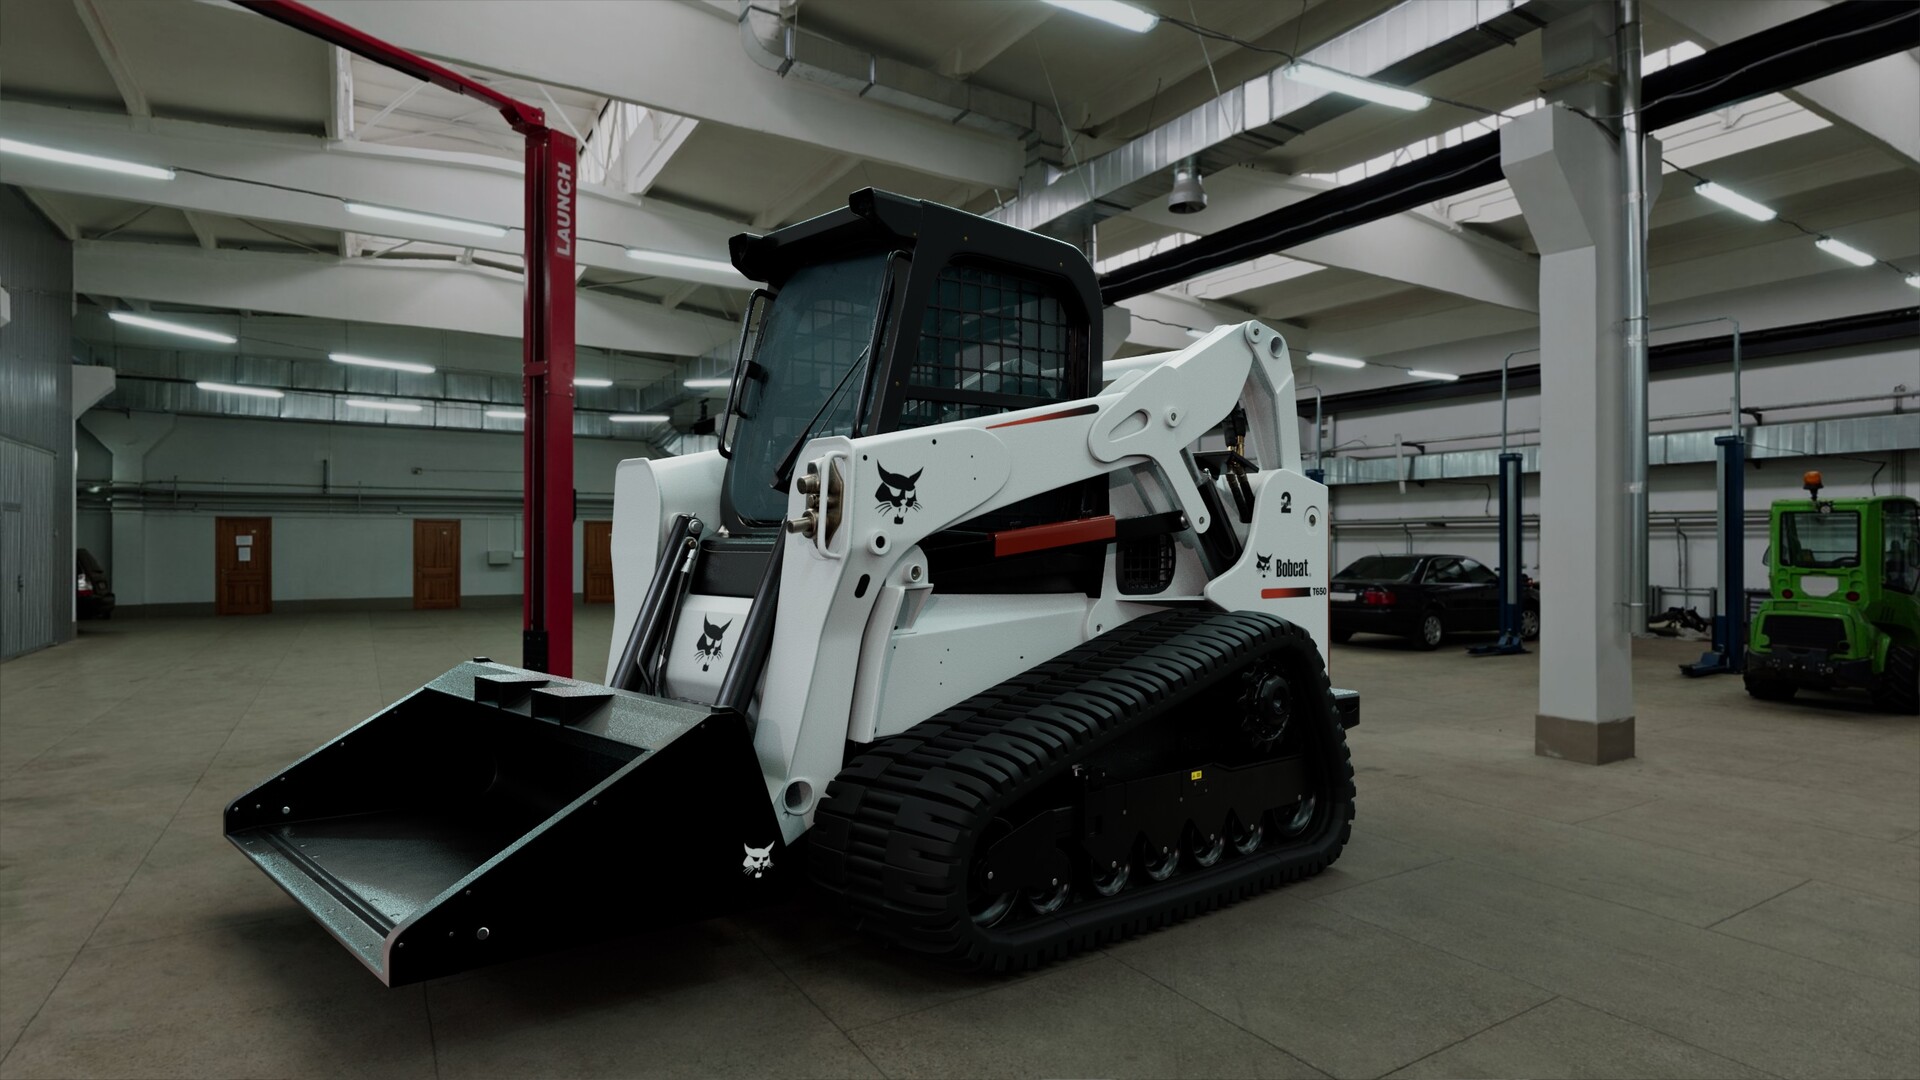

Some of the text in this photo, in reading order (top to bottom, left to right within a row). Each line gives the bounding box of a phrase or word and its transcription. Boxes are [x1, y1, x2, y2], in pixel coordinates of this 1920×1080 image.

[557, 161, 571, 256] LAUNCH
[1281, 491, 1291, 513] 2
[1276, 559, 1308, 577] Bobcat
[1313, 587, 1327, 596] T650
